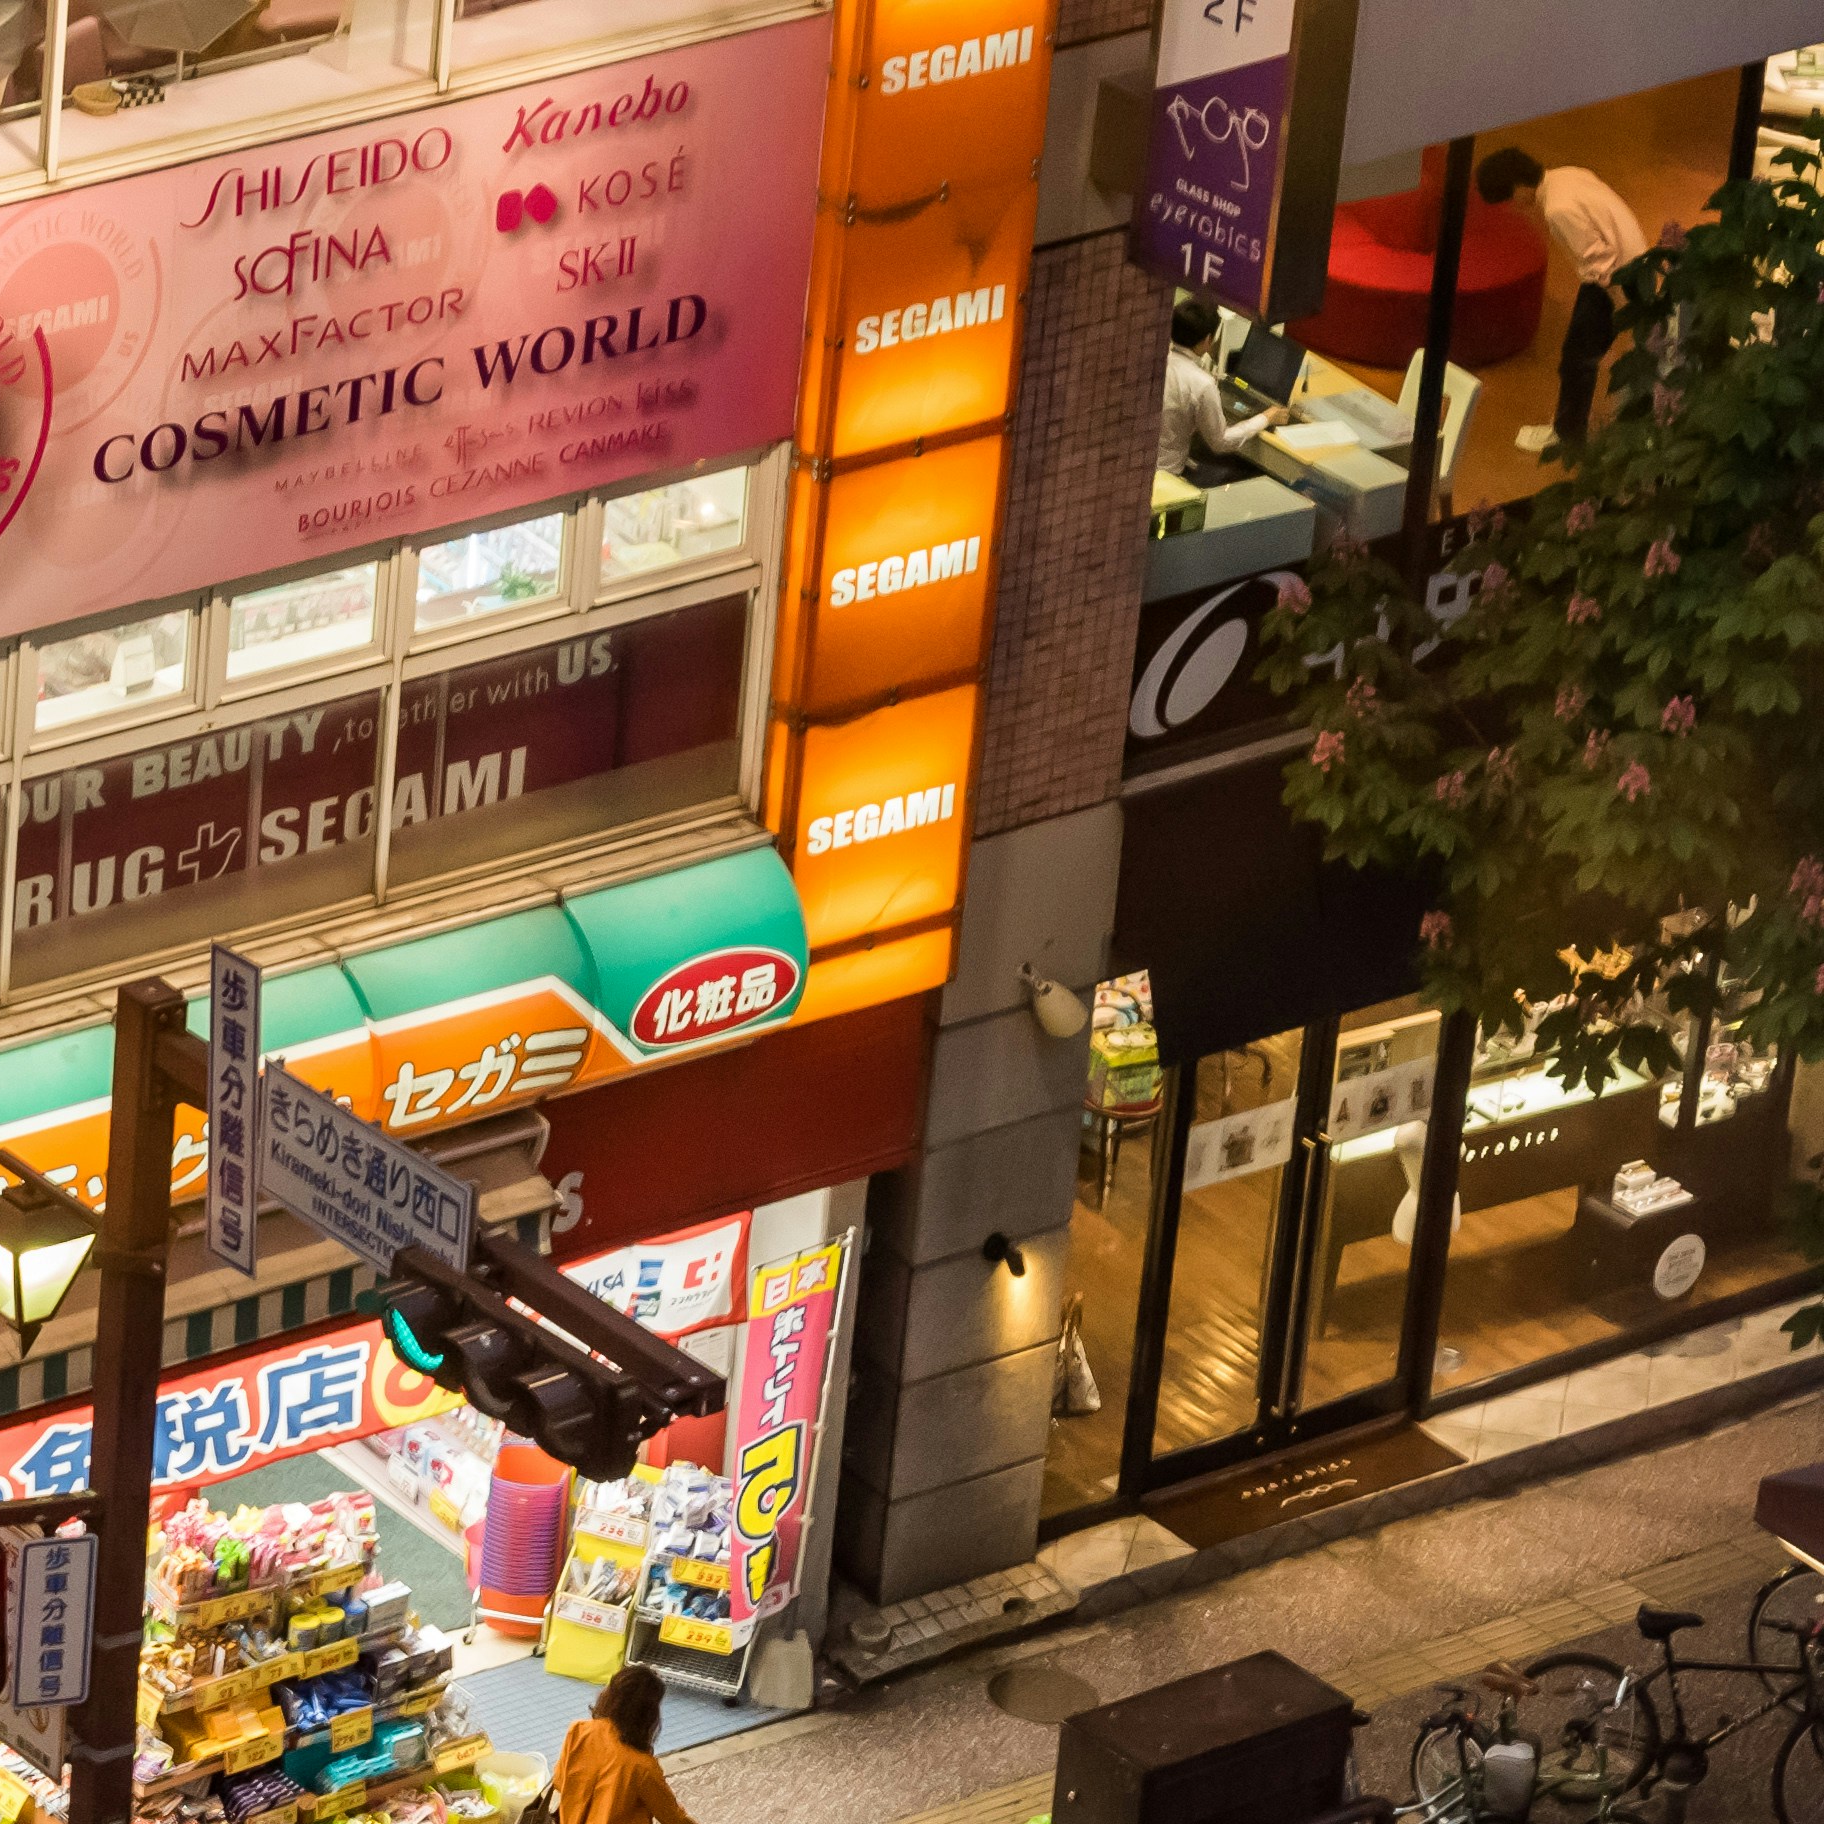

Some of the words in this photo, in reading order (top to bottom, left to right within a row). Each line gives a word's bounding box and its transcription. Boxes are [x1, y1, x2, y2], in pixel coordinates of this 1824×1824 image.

[880, 25, 1035, 96] SEGAMI
[502, 73, 690, 154] Kanebo
[180, 127, 452, 228] SHISEIDO
[577, 147, 688, 214] KOSÉ
[233, 223, 392, 301] SOFINA
[1180, 242, 1224, 284] 1F
[854, 283, 1006, 356] SEGAMI
[93, 357, 445, 485] COSMETIC
[472, 294, 709, 389] WORLD
[298, 489, 416, 534] BOURJOIS
[429, 452, 544, 498] CEZANNE
[559, 420, 669, 464] CANMAKE
[829, 535, 981, 607] SEGAMI
[132, 710, 326, 794] BEAUTY
[487, 666, 549, 704] with
[260, 745, 529, 864] SEGAMI
[806, 783, 955, 857] SEGAMI
[653, 962, 778, 1038] 化粧品
[220, 970, 248, 1252] 歩車分離信号
[385, 1026, 590, 1132] セガミ
[270, 1086, 460, 1244] きらめき通り西口
[312, 1199, 394, 1260] INTERSECTIO
[40, 1547, 70, 1698] 歩車分離信号
